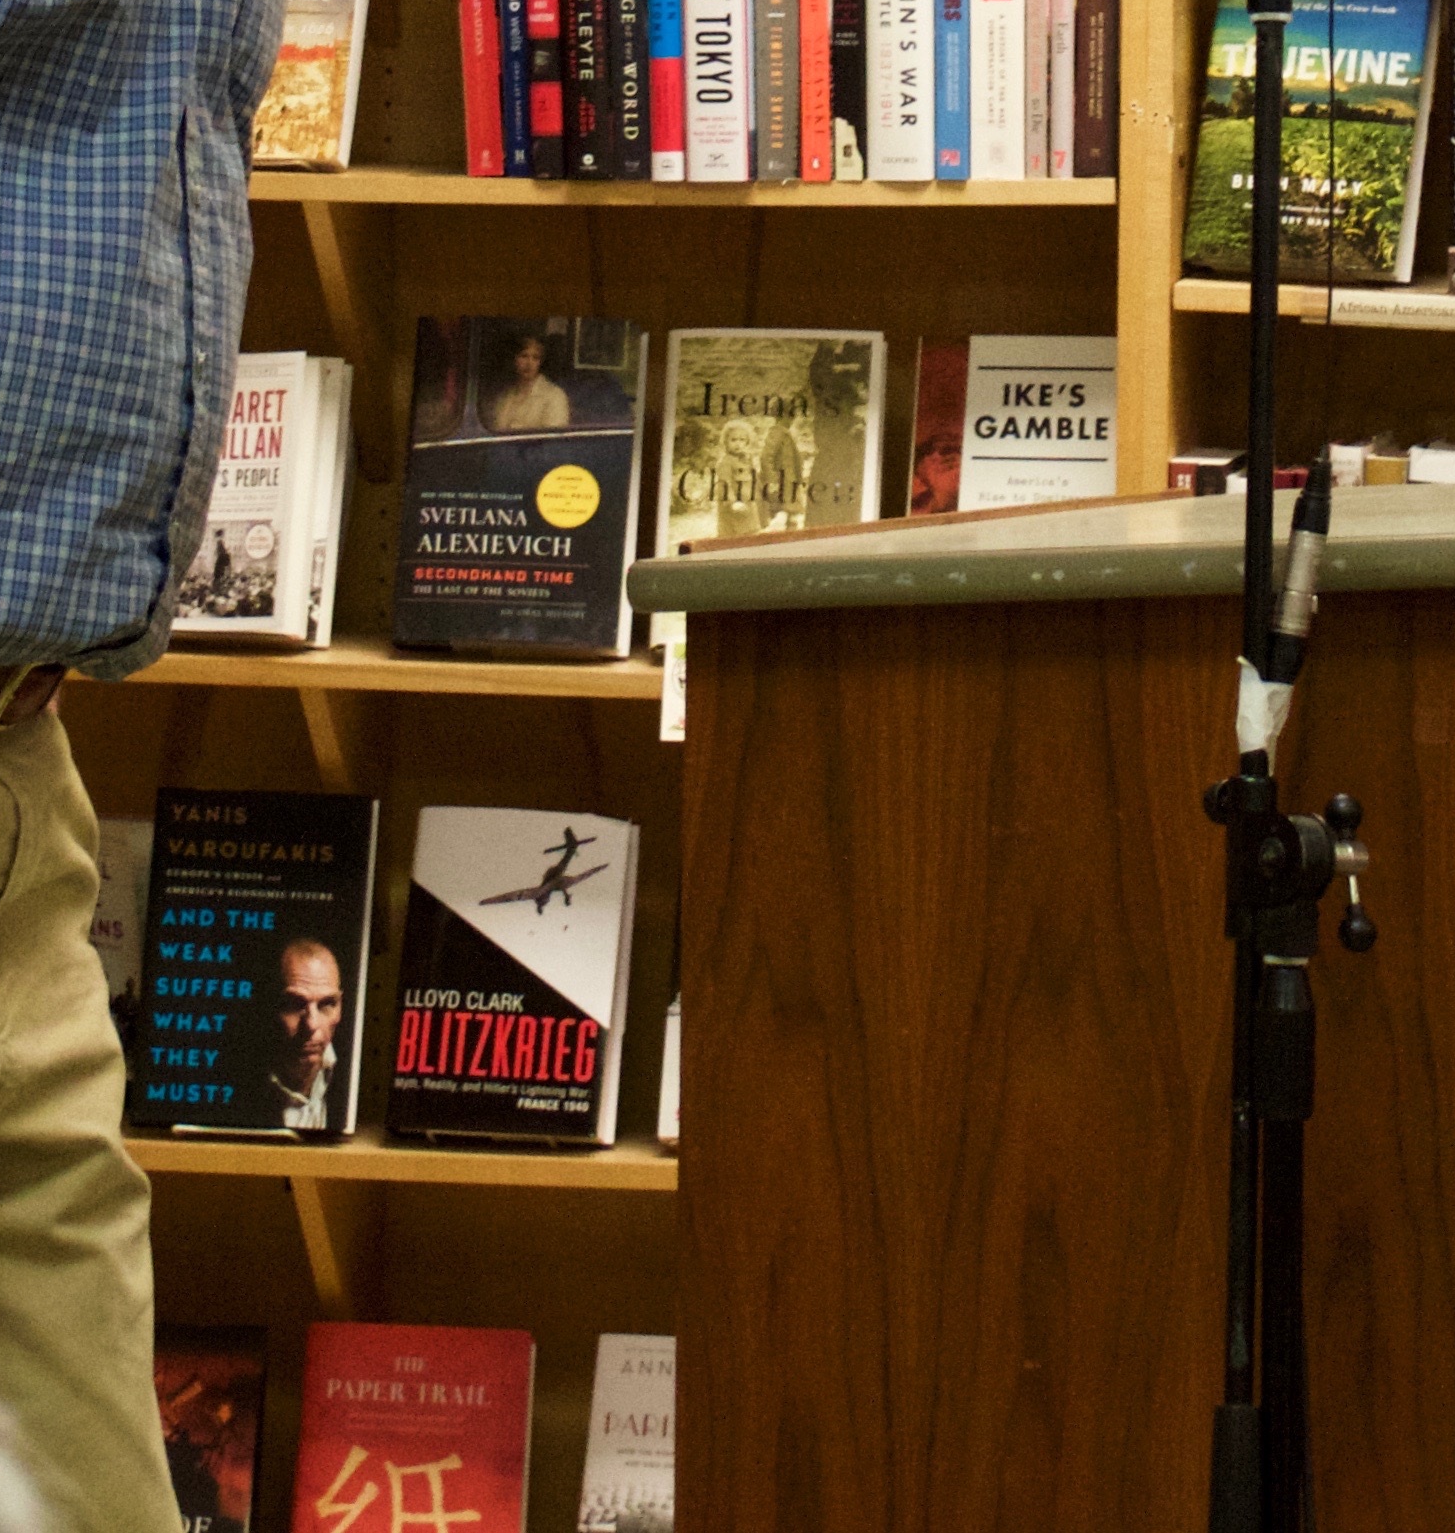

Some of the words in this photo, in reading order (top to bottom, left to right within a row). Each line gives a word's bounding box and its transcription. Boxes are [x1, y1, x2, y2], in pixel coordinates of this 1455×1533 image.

[577, 13, 593, 81] LEYTE
[695, 14, 732, 105] TOKYO
[900, 67, 917, 127] WAR
[1000, 381, 1086, 412] IKE'S
[974, 415, 1110, 442] GAMBLE
[418, 507, 528, 528] SVETLANA
[417, 534, 573, 558] ALEXIEVICH
[415, 568, 528, 584] SECONDHAND
[534, 569, 574, 585] TIME
[161, 907, 217, 927] AND
[227, 909, 275, 930] THE
[159, 943, 232, 962] WEAK
[156, 976, 253, 999] SUFFER
[406, 988, 461, 1008] LLOYD
[466, 991, 524, 1012] CLARK
[154, 1013, 225, 1033] WHAT
[151, 1047, 219, 1067] THEY
[397, 1009, 598, 1082] BLITZKRIEG
[147, 1082, 234, 1104] MUST?
[517, 1096, 559, 1110] FRANCE
